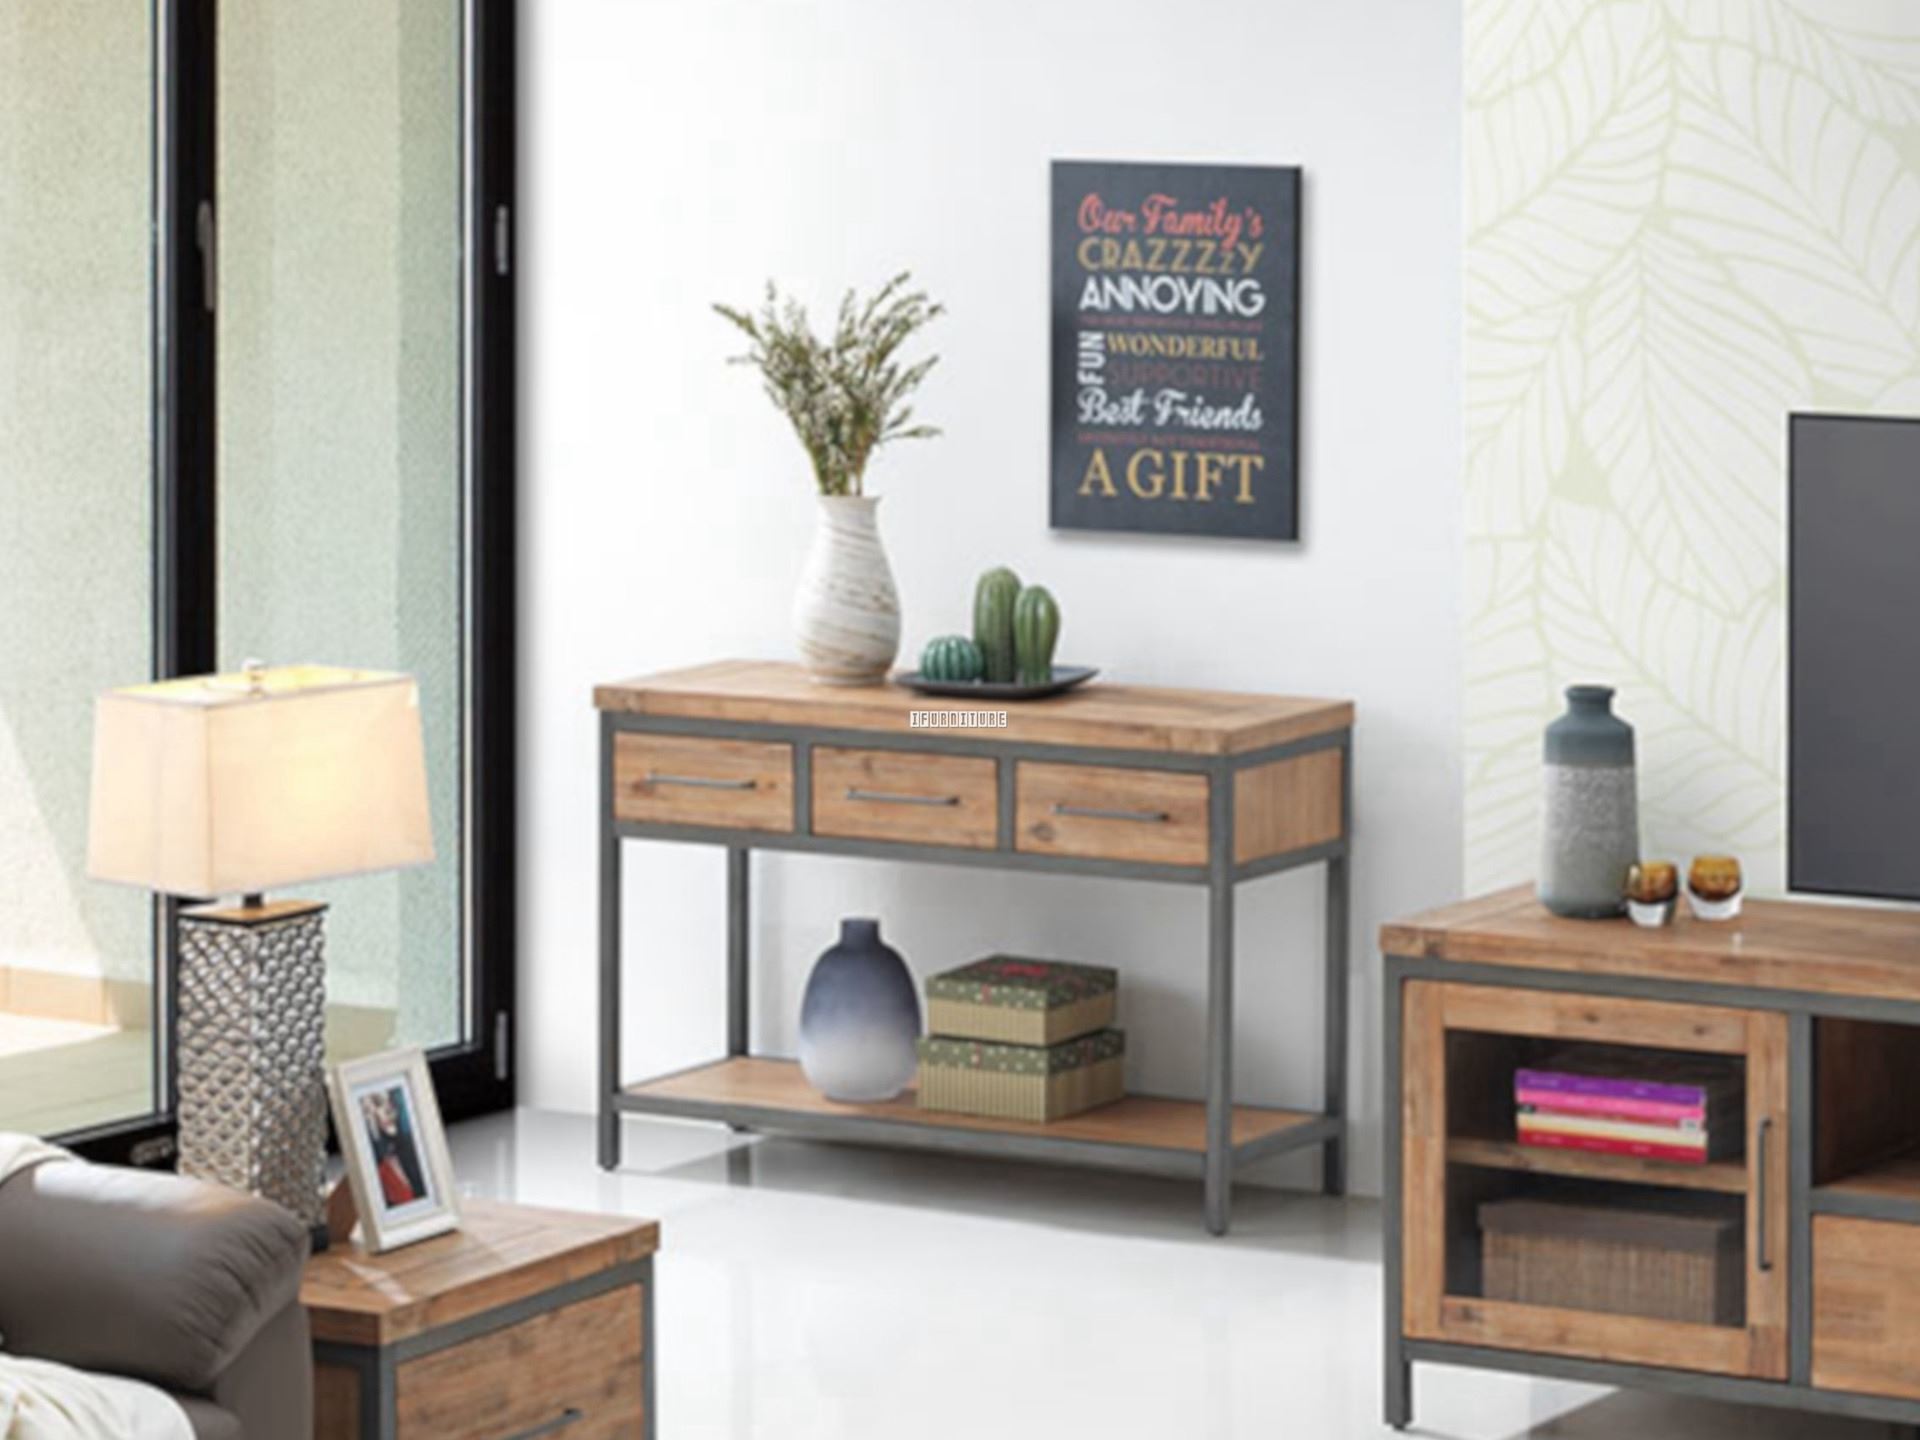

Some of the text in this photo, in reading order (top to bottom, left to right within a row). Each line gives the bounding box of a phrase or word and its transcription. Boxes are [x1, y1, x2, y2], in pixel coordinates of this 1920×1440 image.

[1078, 193, 1264, 250] Our Family's
[1079, 275, 1266, 317] ANNOYING
[1077, 330, 1105, 386] FUN
[1107, 332, 1264, 361] WONDERFUL
[1077, 386, 1263, 431] Best Friends
[1078, 448, 1265, 504] A GIFT
